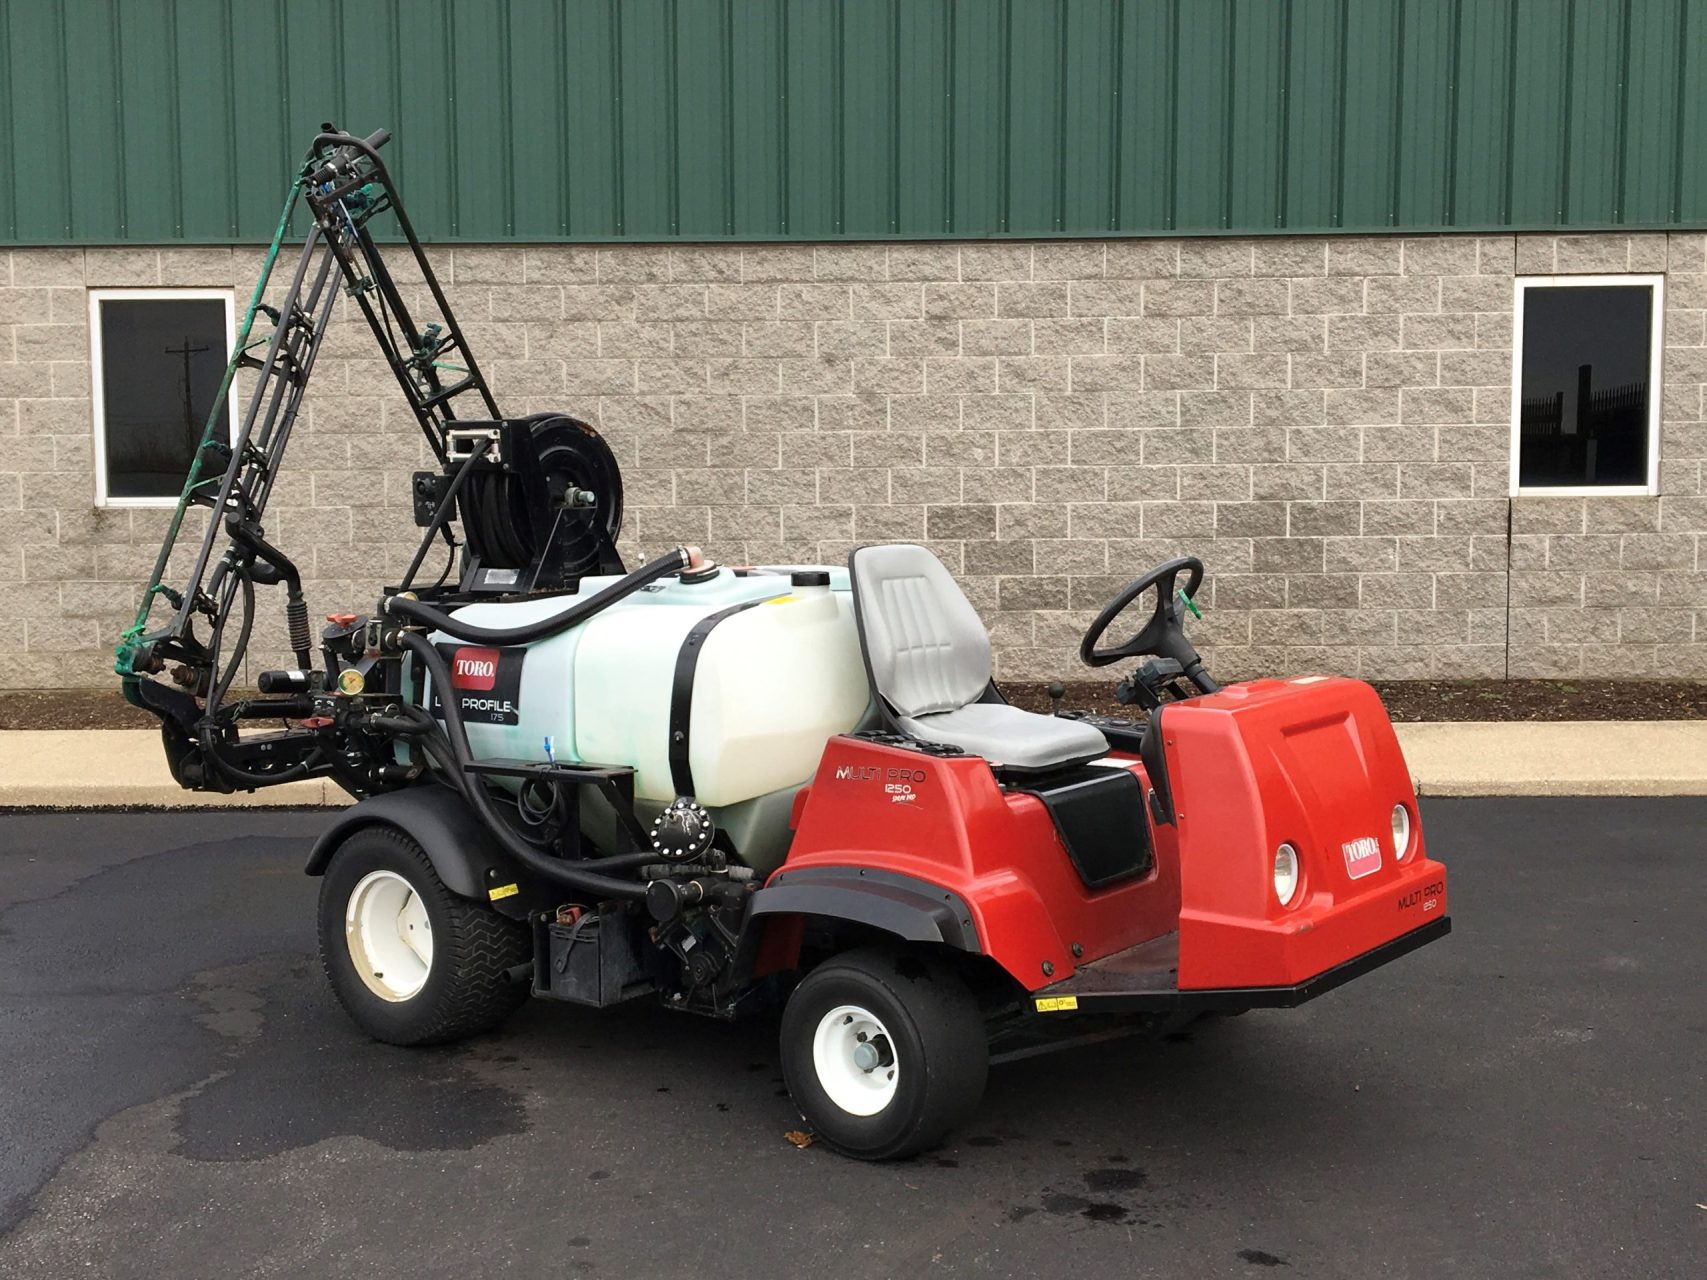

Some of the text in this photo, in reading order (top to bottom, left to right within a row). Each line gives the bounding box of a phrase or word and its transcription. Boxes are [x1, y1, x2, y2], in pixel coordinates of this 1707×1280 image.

[456, 660, 494, 677] TORO
[462, 698, 510, 712] PROFILE
[490, 713, 504, 721] 175
[836, 766, 926, 783] MULTI PRO
[884, 783, 912, 794] 1250
[1345, 838, 1377, 862] TORO
[1398, 881, 1444, 910] MULTI PRO
